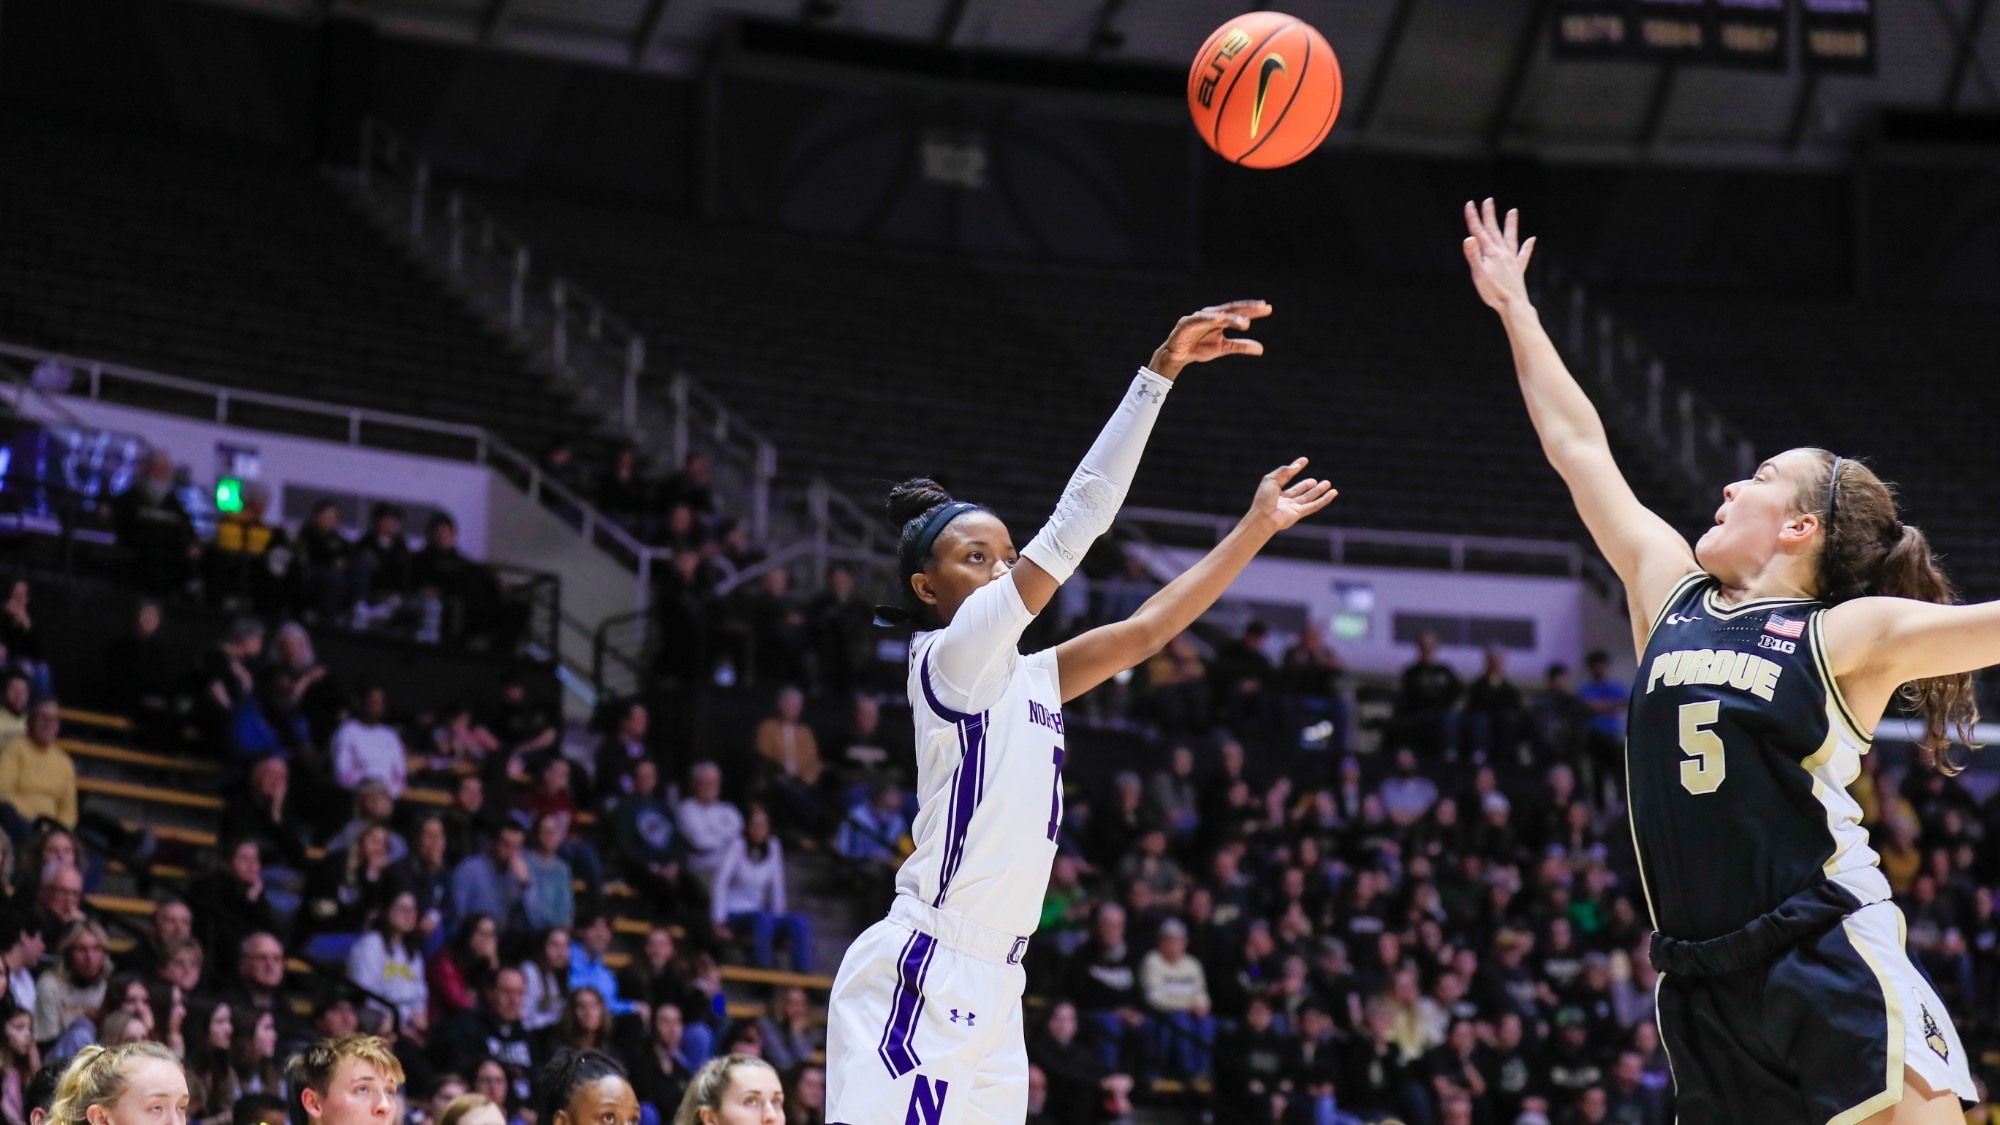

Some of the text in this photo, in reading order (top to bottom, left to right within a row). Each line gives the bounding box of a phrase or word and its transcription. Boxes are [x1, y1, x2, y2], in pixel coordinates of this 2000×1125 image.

[1197, 28, 1252, 111] ELITE
[1646, 648, 1784, 702] PURDUE
[1678, 700, 1726, 795] 5
[905, 1073, 949, 1125] N
